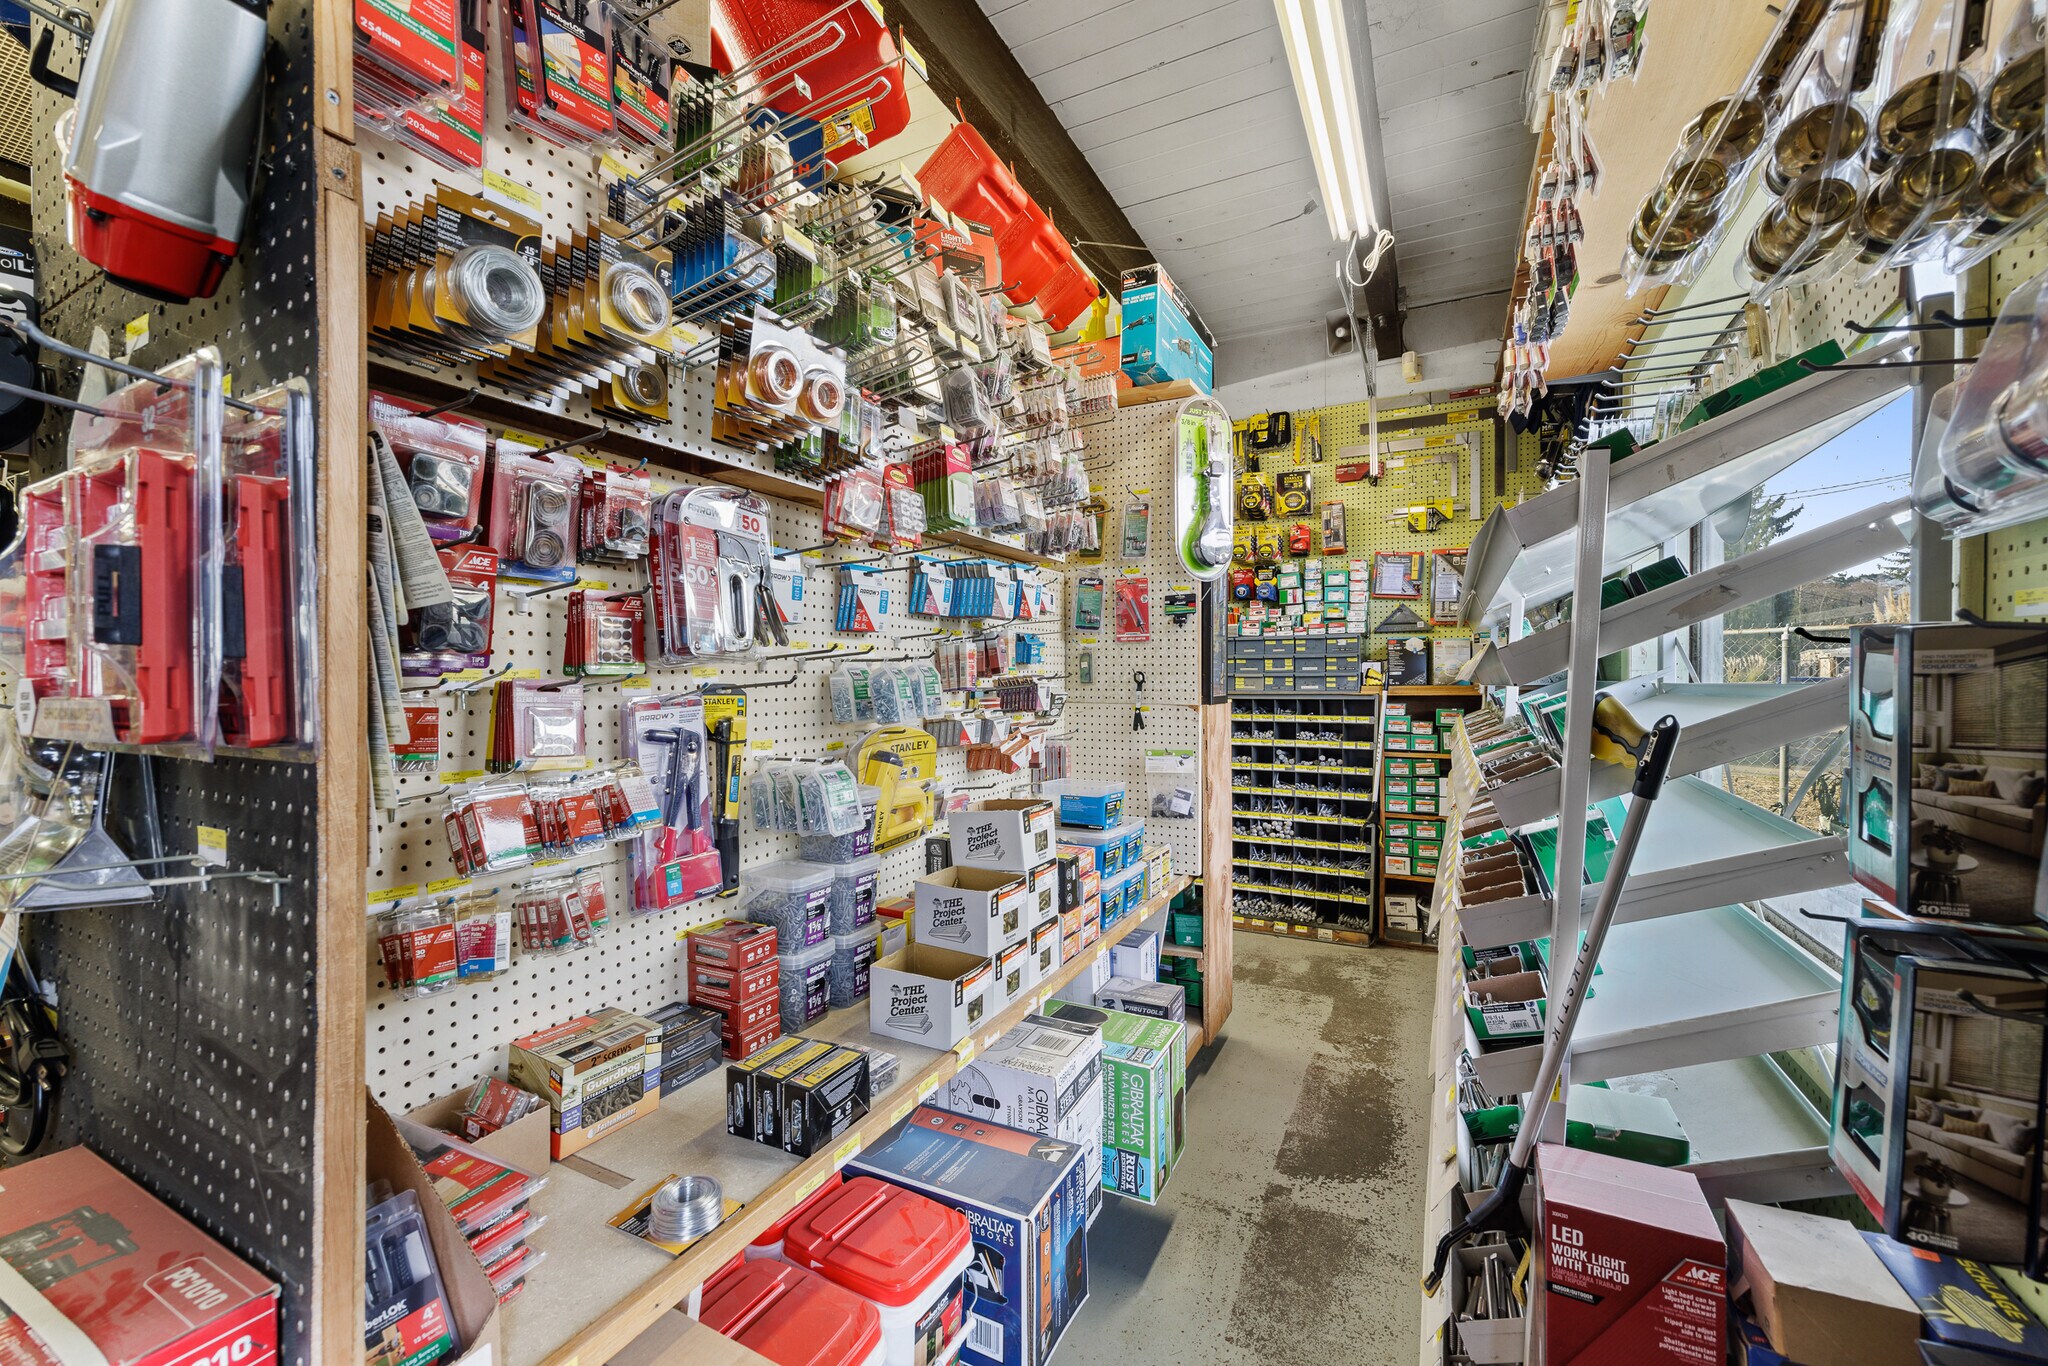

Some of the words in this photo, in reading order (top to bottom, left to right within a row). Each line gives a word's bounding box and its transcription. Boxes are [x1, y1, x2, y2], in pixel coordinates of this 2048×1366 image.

[545, 7, 586, 36] TimberLOK
[360, 15, 401, 48] 254mm
[620, 57, 653, 87] TimberLOK
[550, 90, 576, 108] 152mm
[407, 117, 440, 141] 203mm
[469, 455, 480, 466] 4
[571, 482, 580, 491] 4
[468, 556, 491, 567] ACE
[478, 580, 490, 592] 4
[471, 656, 485, 664] TIPS
[704, 697, 736, 706] STANLEY
[639, 713, 669, 722] ARROW
[890, 740, 929, 753] STANLEY
[1865, 755, 1891, 768] SCHLAGE
[876, 810, 885, 843] STANLEY
[975, 822, 993, 835] THE
[968, 829, 999, 846] Project
[968, 839, 998, 852] Center
[858, 873, 878, 885] ROCK-O
[810, 886, 832, 900] ROCK-O
[943, 898, 963, 909] THE
[1917, 904, 1940, 915] 40
[932, 907, 966, 920] Project
[932, 917, 964, 929] Center
[857, 940, 877, 954] ROCK-O
[810, 960, 832, 974] ROCK-O
[903, 984, 926, 996] THE
[891, 994, 928, 1007] Project
[890, 1005, 926, 1017] Center
[646, 1036, 659, 1045] FREE
[603, 1043, 633, 1063] SCREWS
[550, 1070, 561, 1083] FREE
[586, 1061, 641, 1093] GuardDog
[583, 1087, 608, 1102] EXTERIOR
[608, 1078, 627, 1091] WOOD
[627, 1070, 644, 1083] SCREW
[1107, 1063, 1115, 1120] GALVANIZED
[597, 1107, 638, 1132] FastenMaster
[1130, 1074, 1144, 1150] GIBRALTAR
[1107, 1120, 1115, 1145] STEEL
[1126, 1154, 1137, 1193] RUST
[454, 1200, 485, 1220] 54mm
[970, 1227, 1015, 1248] ILBOXES
[1551, 1223, 1584, 1248] LED
[1907, 1231, 1928, 1242] 40
[1551, 1242, 1588, 1262] WORK
[1591, 1253, 1628, 1273] LIGHT
[1551, 1253, 1582, 1273] WITH
[1586, 1262, 1630, 1286] TRIPOD
[1551, 1273, 1564, 1282] CON
[1685, 1266, 1721, 1285] ACE
[164, 1266, 229, 1311] PC1010
[1578, 1273, 1595, 1285] PARA
[1595, 1278, 1622, 1292] TRABAJO
[1677, 1276, 1696, 1286] QUALITY
[1696, 1281, 1711, 1289] SINCE
[1956, 1258, 2030, 1322] SCHLAGE
[1552, 1284, 1594, 1300] INDOOR/OUTDOOR
[1662, 1286, 1679, 1297] Light
[1679, 1289, 1695, 1300] head
[1695, 1296, 1707, 1304] can
[1708, 1298, 1717, 1306] be
[423, 1302, 438, 1320] 4"
[919, 1292, 950, 1330] TimberLOK
[1664, 1294, 1691, 1306] adjusted
[1691, 1300, 1717, 1313] forward
[1673, 1302, 1685, 1311] and
[1685, 1305, 1717, 1319] backward
[365, 1299, 407, 1330] berLOK
[1664, 1316, 1683, 1329] Tripod
[1684, 1322, 1696, 1331] can
[1697, 1326, 1717, 1337] adjust
[1681, 1328, 1694, 1337] side
[1703, 1333, 1717, 1343] side
[407, 1354, 419, 1365] Log
[418, 1343, 439, 1360] Screws
[1659, 1342, 1702, 1359] polycarbonate
[1703, 1353, 1717, 1363] lens
[1663, 1336, 1717, 1357] Shatter-resistant
